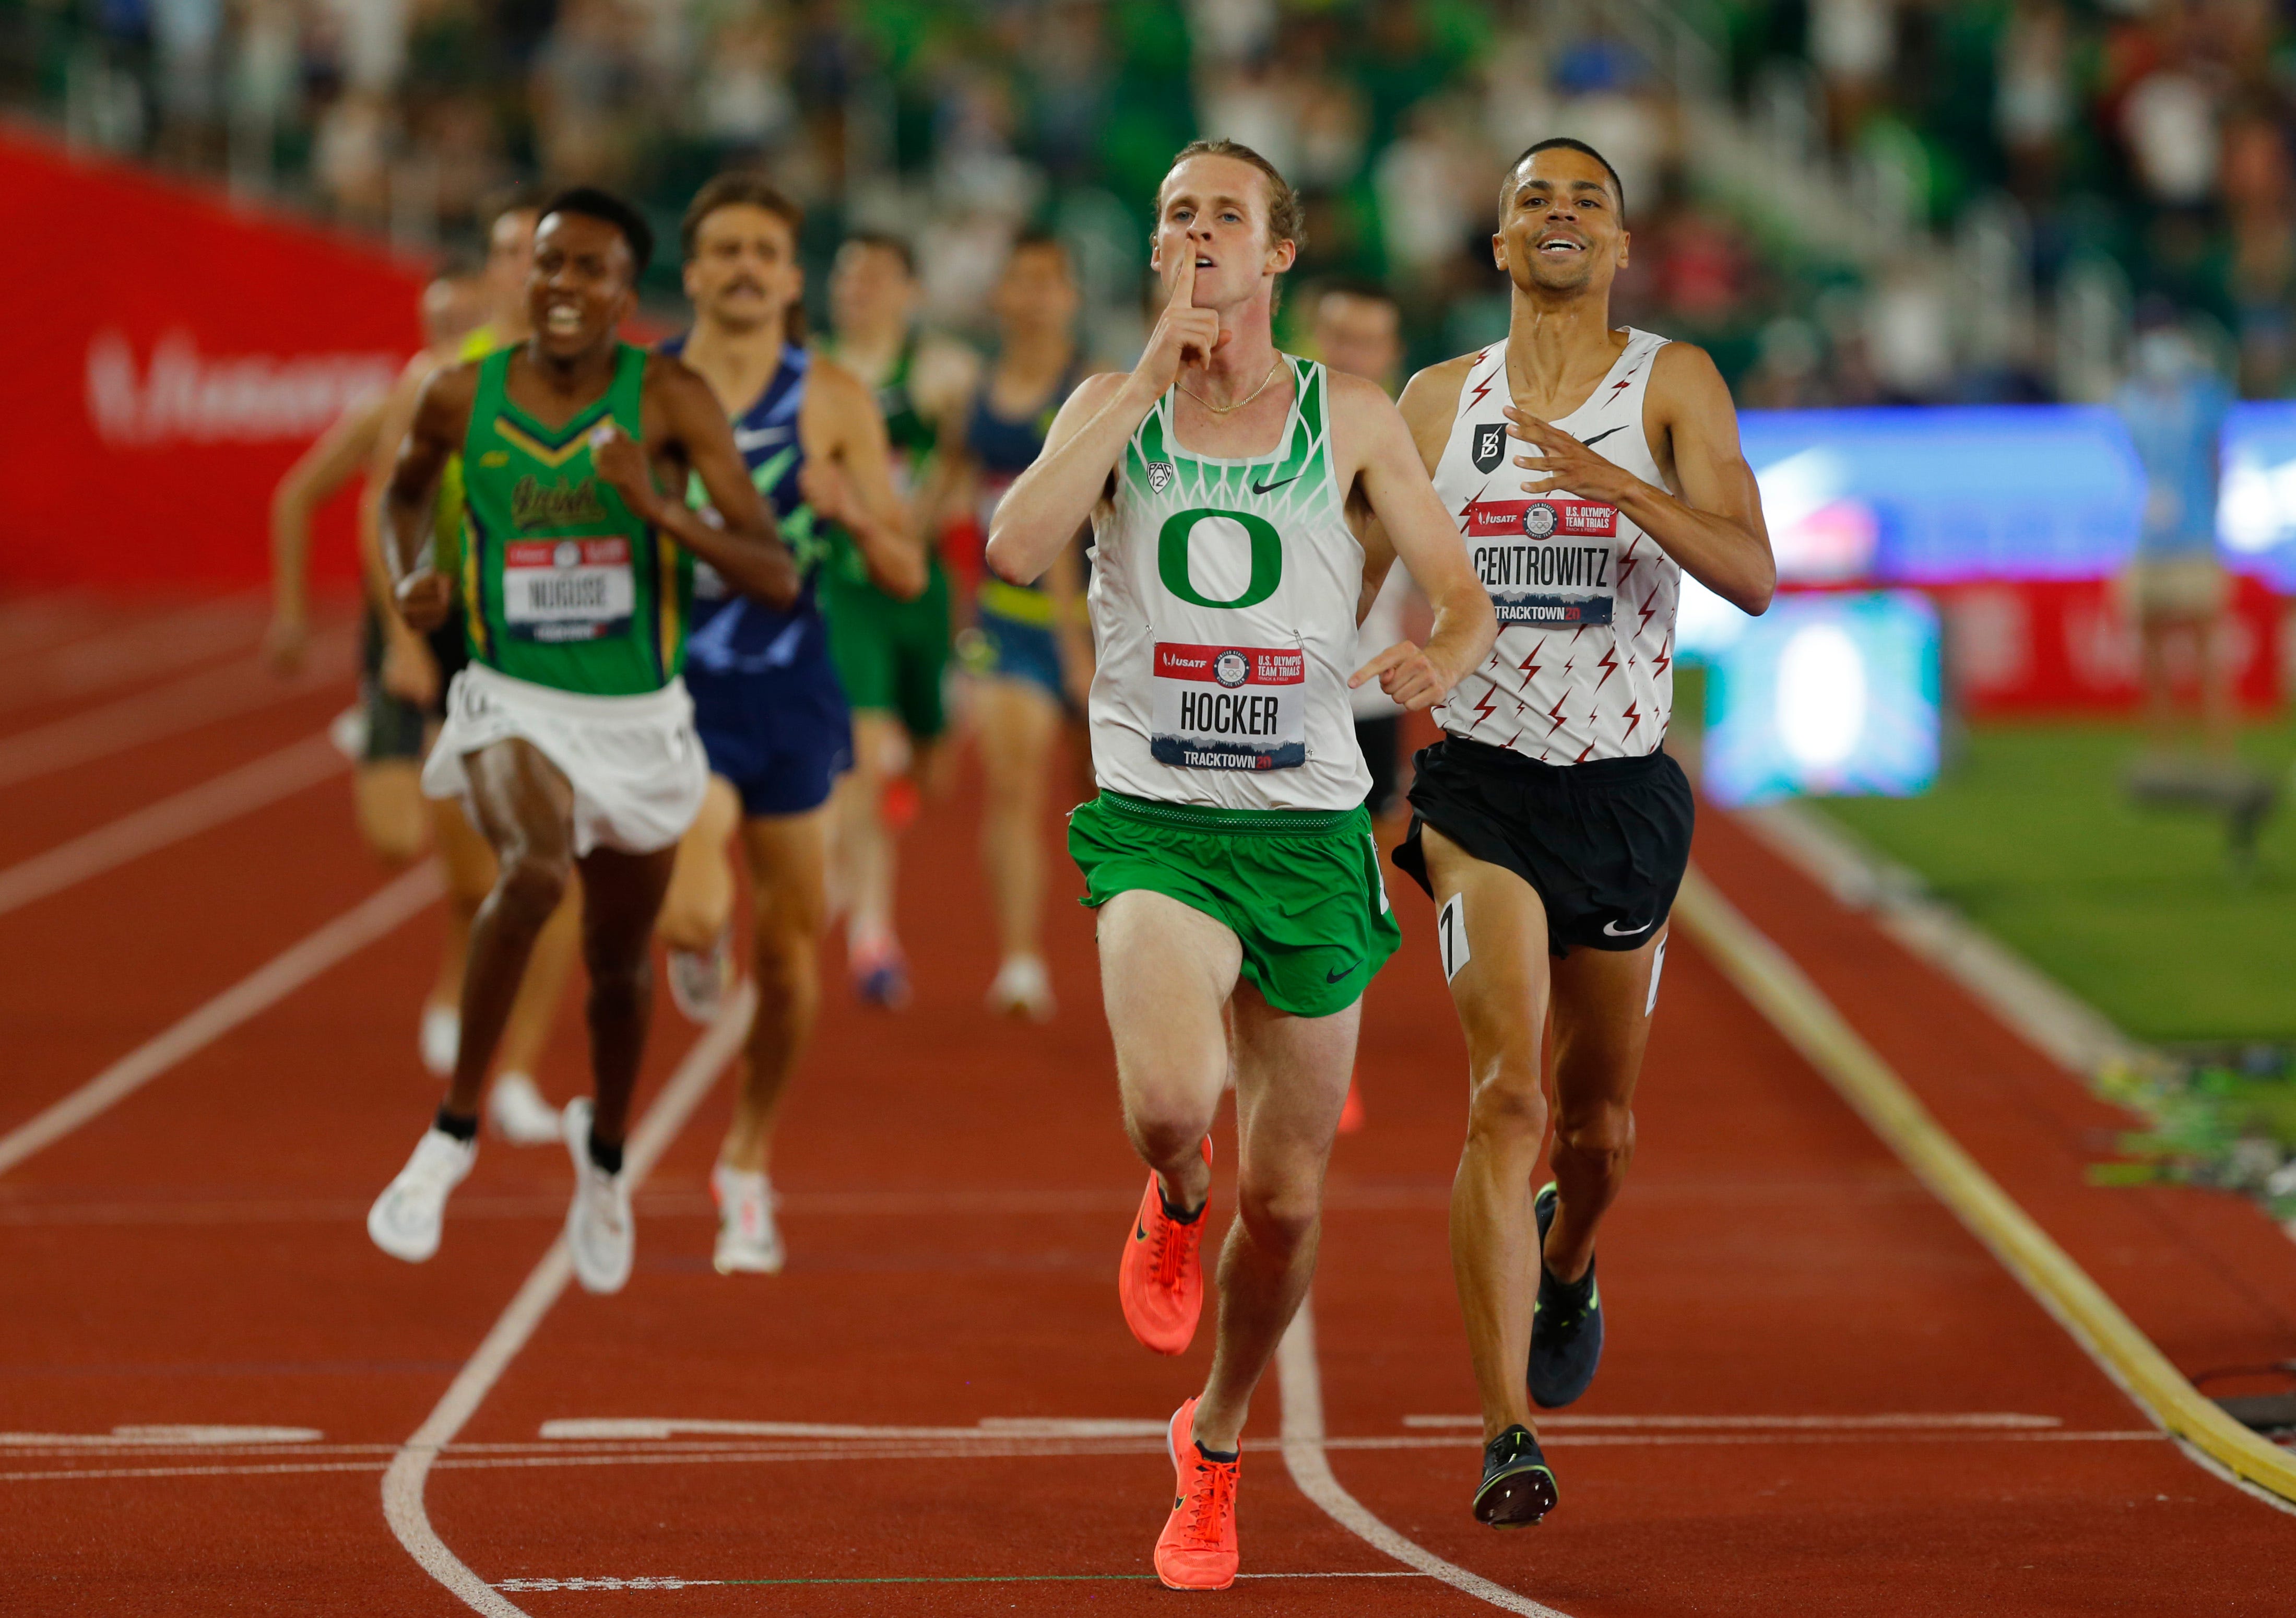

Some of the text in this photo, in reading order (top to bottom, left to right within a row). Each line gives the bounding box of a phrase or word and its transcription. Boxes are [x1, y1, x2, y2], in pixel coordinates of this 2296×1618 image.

[1149, 464, 1171, 481] PAC
[1152, 476, 1165, 487] 12
[1526, 503, 1540, 513] UNITED
[1566, 506, 1610, 518] U.S. OLYMPIC
[1490, 515, 1518, 524] USATF
[1565, 517, 1609, 528] TEAM TRIALS
[1157, 508, 1282, 609] O
[1474, 546, 1609, 588] CENTROWITZ
[1175, 658, 1207, 668] USATF
[1258, 655, 1301, 666] U.S. OLYMPIC
[1258, 666, 1300, 677] TEAM TRIALS
[1180, 691, 1279, 735] HOCKER
